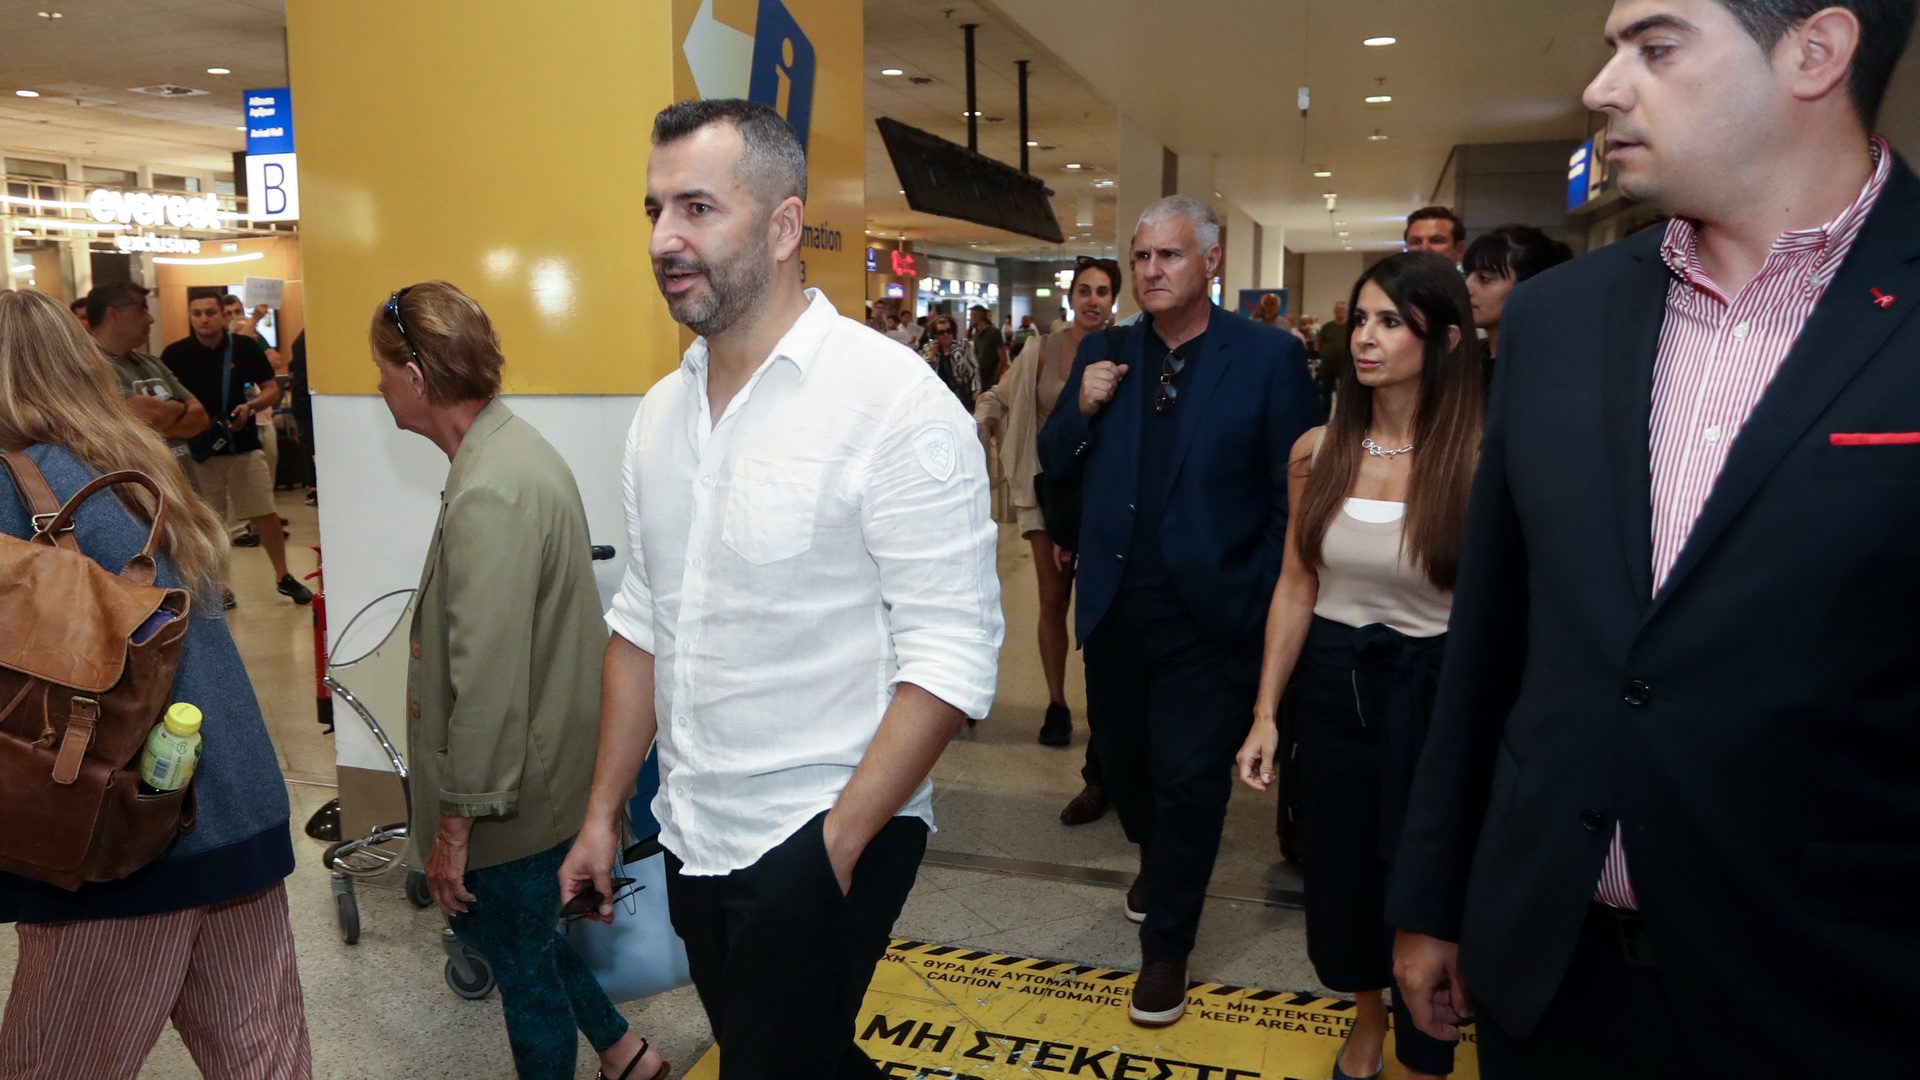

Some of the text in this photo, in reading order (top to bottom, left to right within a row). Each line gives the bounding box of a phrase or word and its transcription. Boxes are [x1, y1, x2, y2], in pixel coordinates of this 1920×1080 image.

[263, 163, 287, 215] B
[89, 188, 221, 230] everest
[117, 232, 201, 254] exclusive
[800, 220, 842, 252] mation
[923, 959, 966, 973] ΘΥΡΑ
[971, 966, 999, 978] ΜΕ
[1001, 971, 1096, 992] ΑΥΤΟΜΑΤΗ
[926, 971, 1001, 989] CAUTION
[1019, 985, 1123, 1007] AUTOMATIC
[1200, 1010, 1250, 1024] KEEP
[1255, 1018, 1308, 1034] AREA
[1314, 1026, 1351, 1039] CLE
[859, 1014, 957, 1053] ΜΗ
